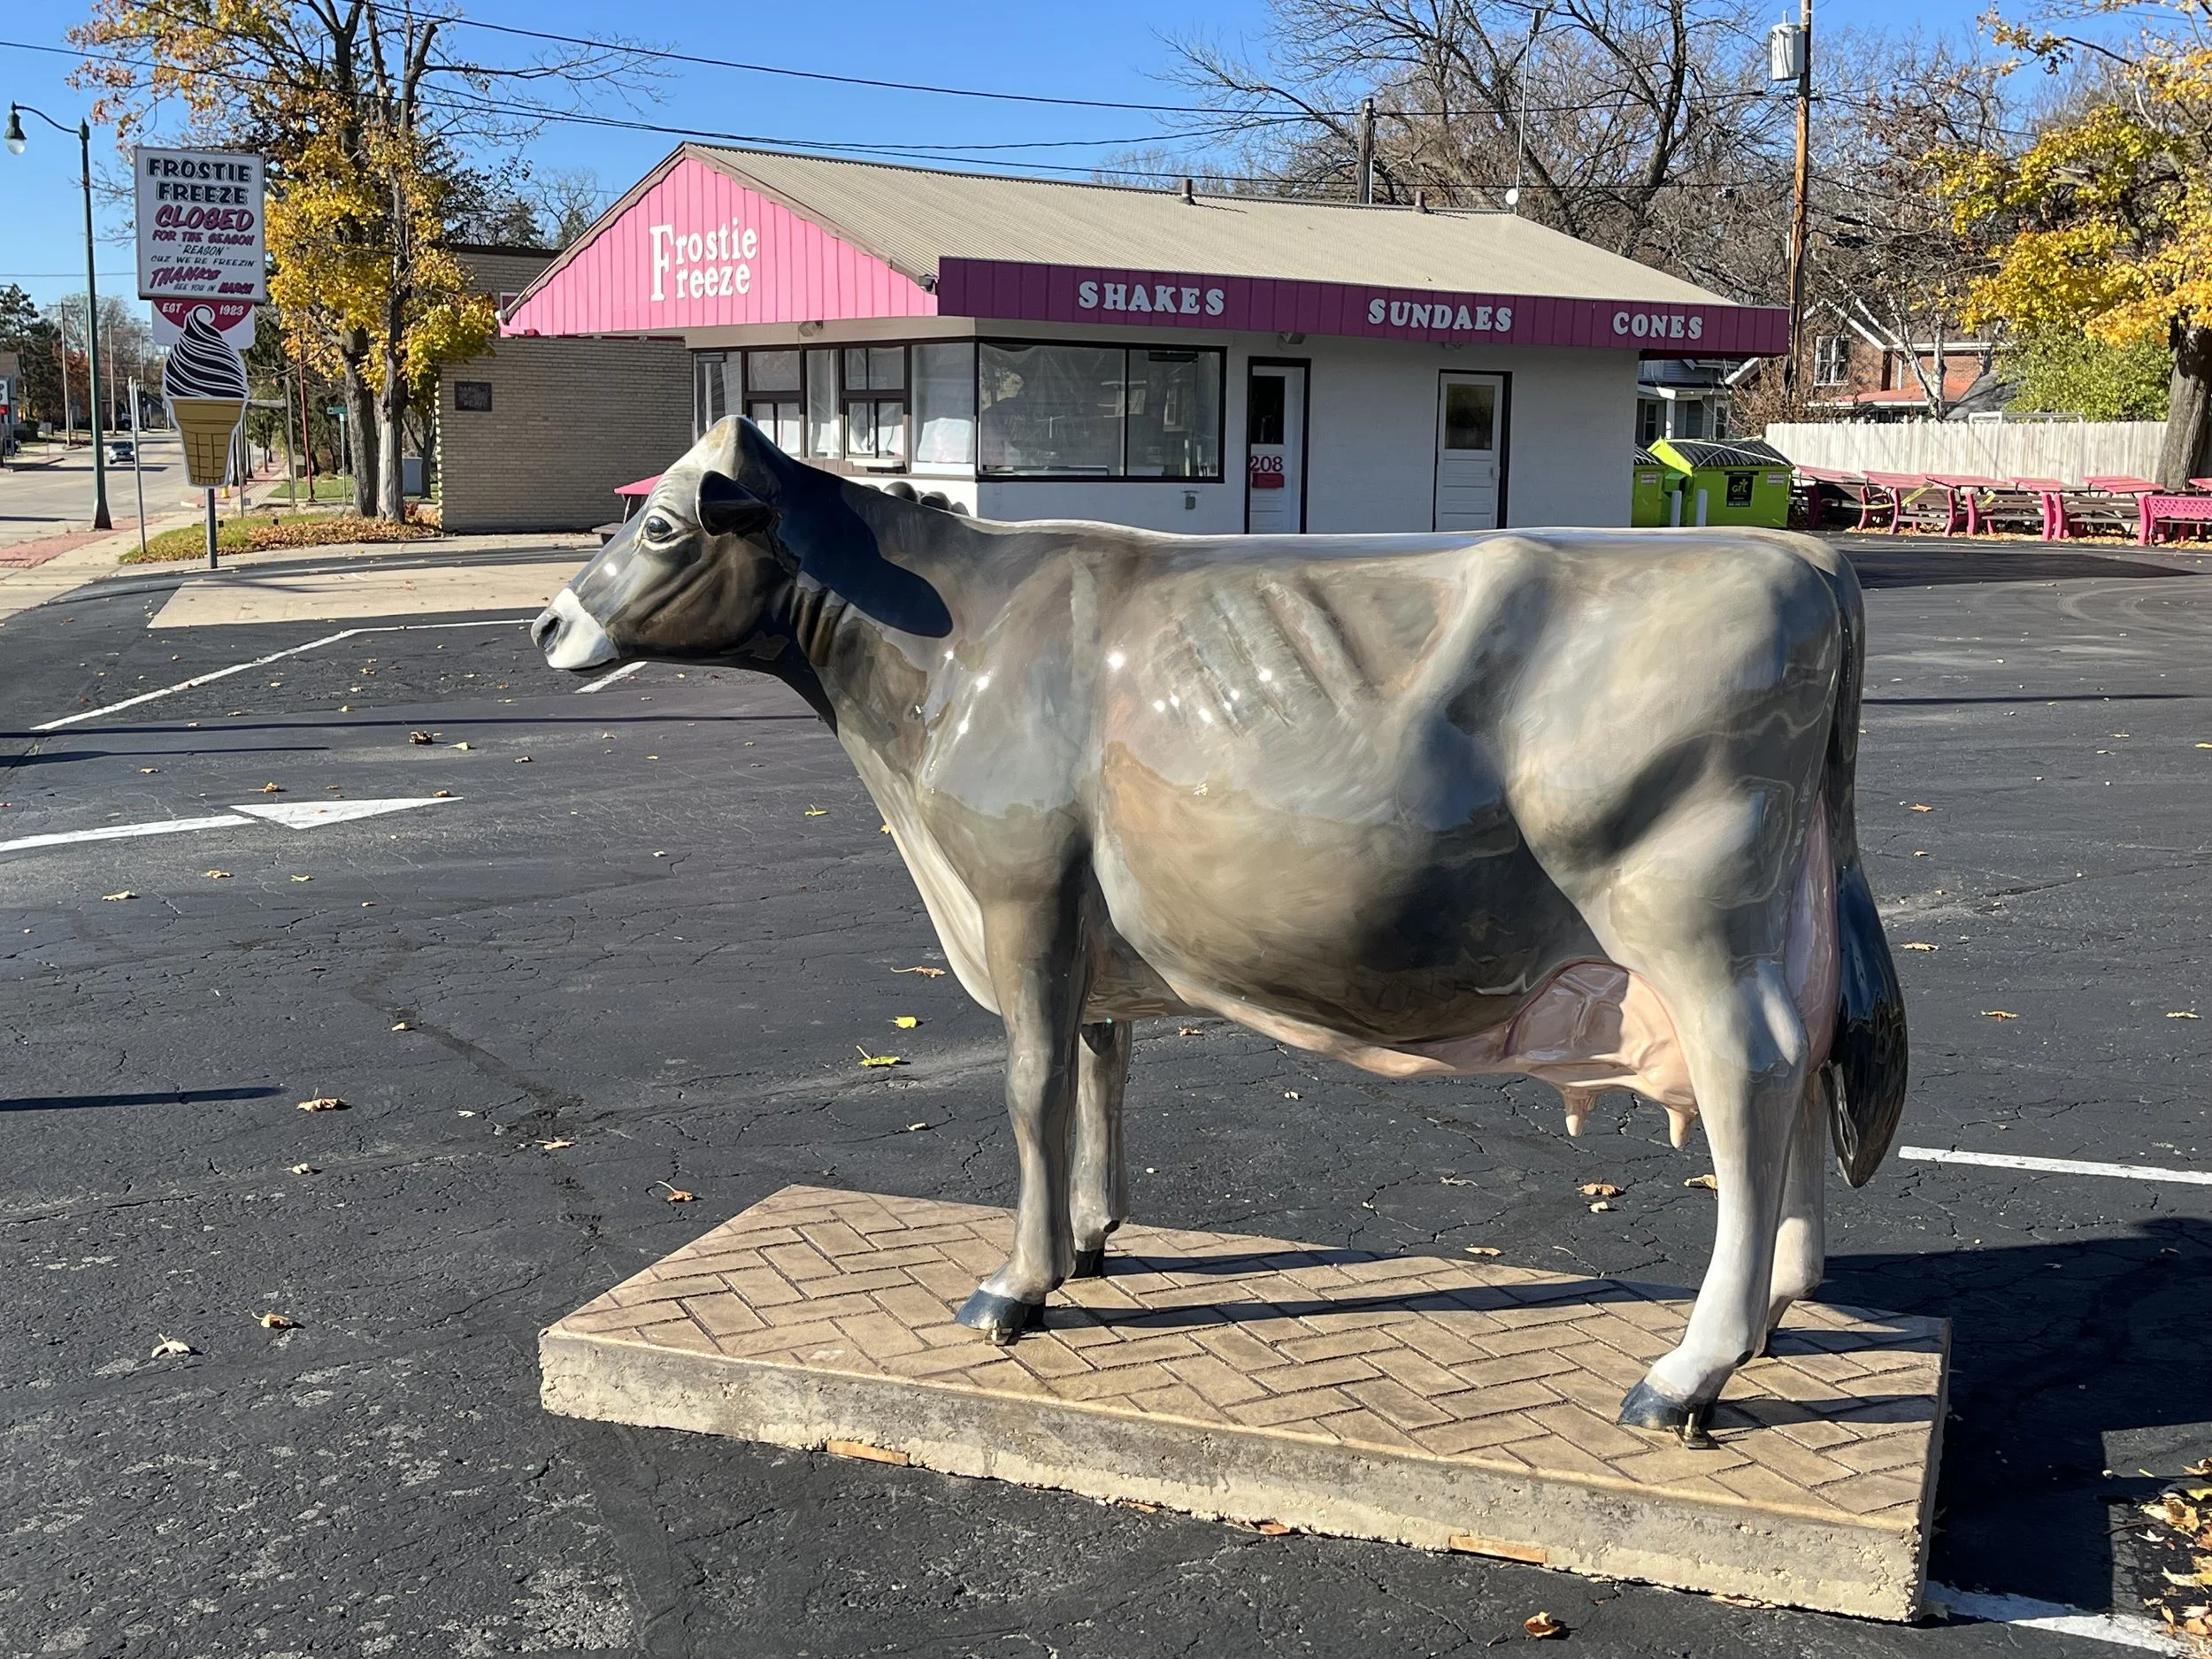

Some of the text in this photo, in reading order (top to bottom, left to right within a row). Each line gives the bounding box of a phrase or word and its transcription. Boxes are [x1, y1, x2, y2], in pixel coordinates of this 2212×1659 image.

[147, 157, 252, 182] FROSTIE
[156, 181, 249, 205] FREEZE
[155, 204, 255, 232] CLOSED
[152, 229, 255, 246] FOR THE SEASON
[649, 217, 758, 301] Frostie
[150, 265, 221, 288] THANKS
[219, 305, 244, 316] 1923
[1078, 280, 1225, 316] SHAKES
[1368, 298, 1512, 332] SUNDAES
[1613, 311, 1703, 340] CONES
[1249, 456, 1283, 472] 208
